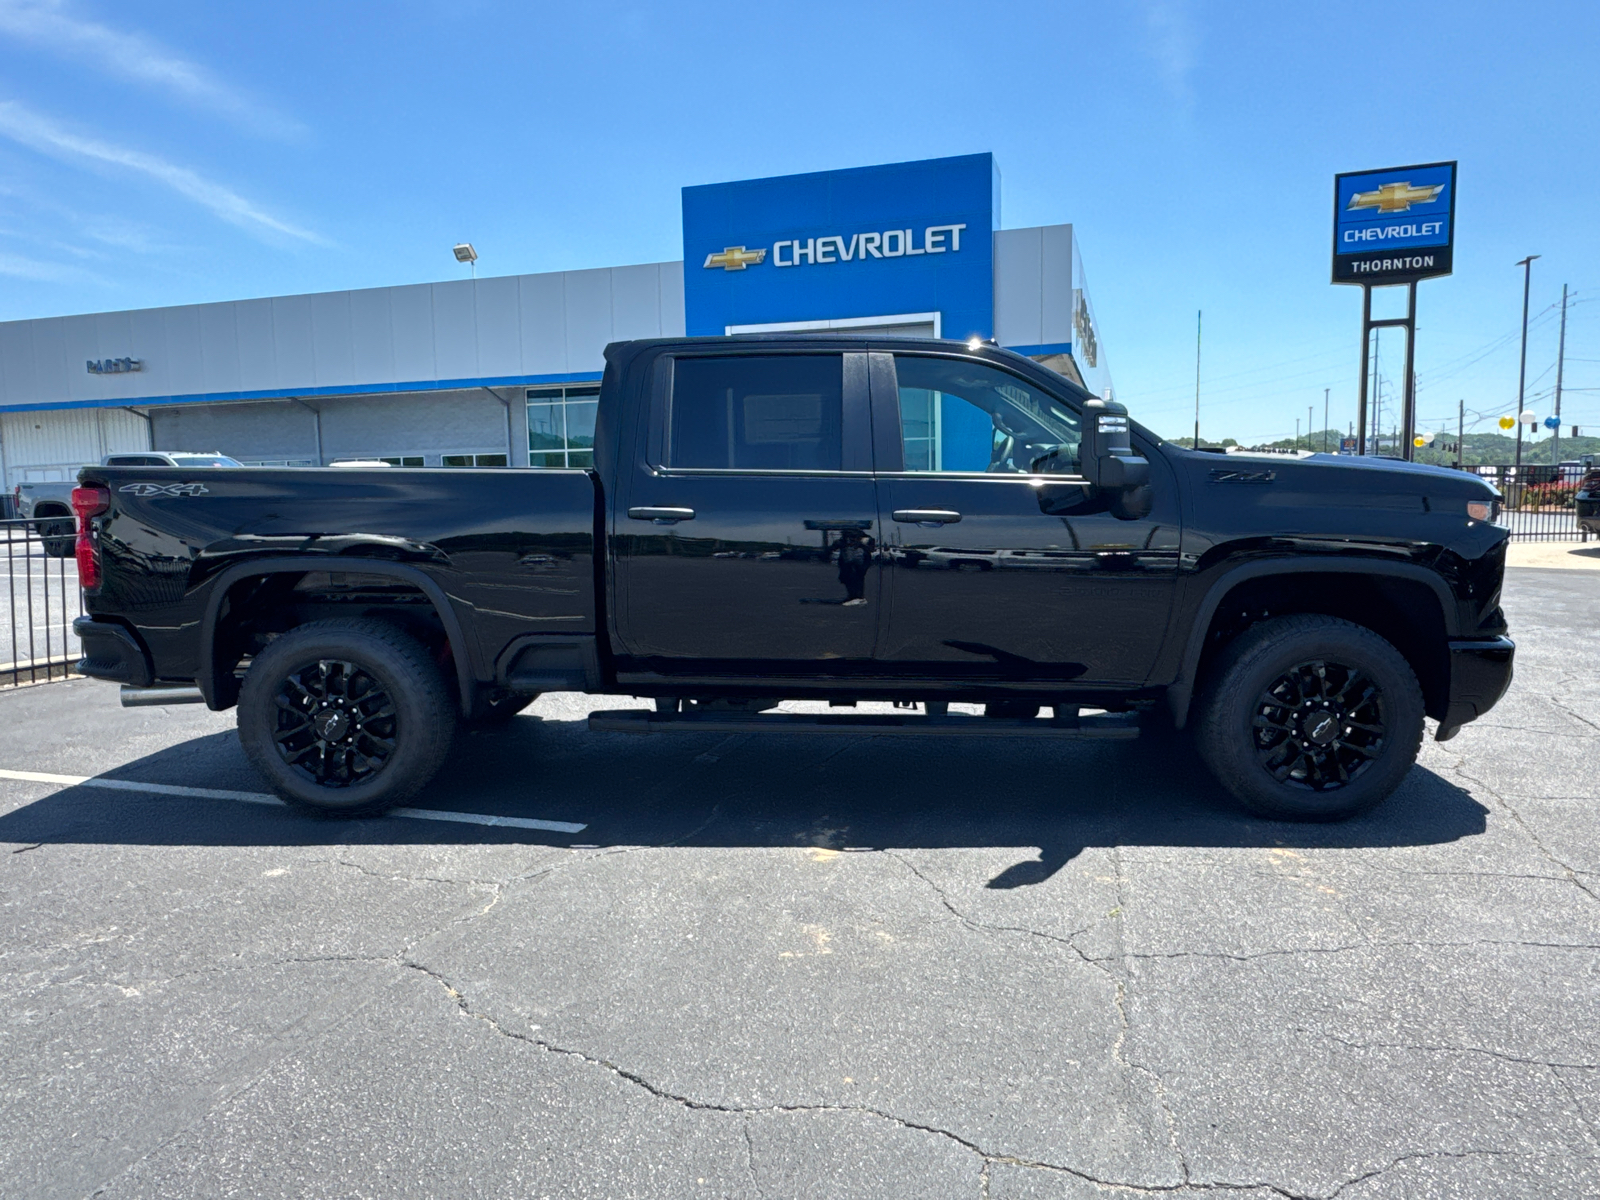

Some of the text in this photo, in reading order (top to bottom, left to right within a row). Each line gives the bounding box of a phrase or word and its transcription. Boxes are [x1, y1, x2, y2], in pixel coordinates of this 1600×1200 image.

[1344, 221, 1443, 243] CHEVROLET
[773, 223, 967, 267] CHEVROLET
[1351, 255, 1434, 273] THORNTON
